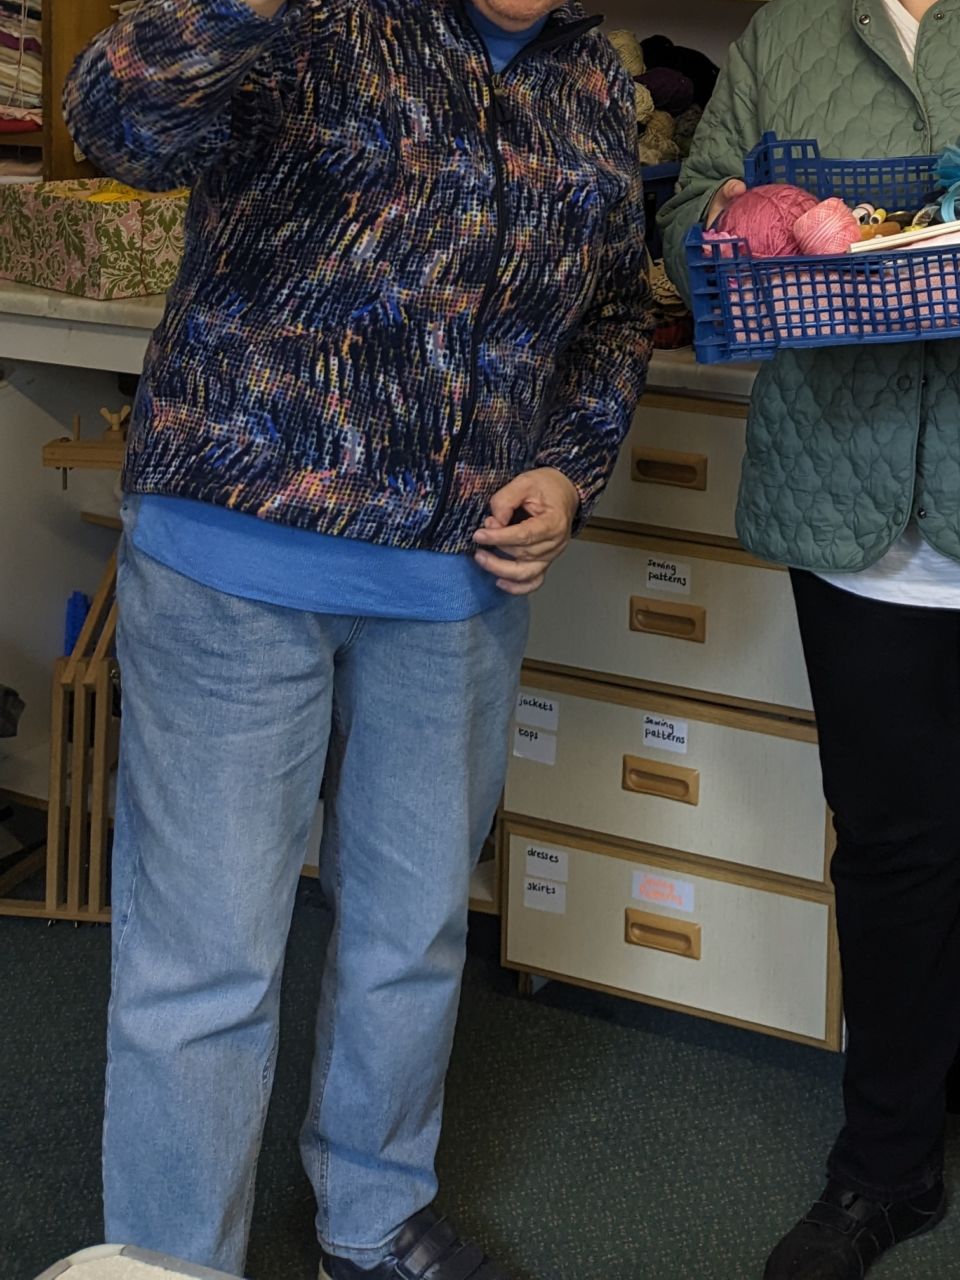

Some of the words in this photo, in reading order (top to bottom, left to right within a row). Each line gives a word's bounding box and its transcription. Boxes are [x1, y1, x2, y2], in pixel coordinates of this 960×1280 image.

[518, 693, 554, 712] jackets
[518, 727, 539, 741] tops
[527, 847, 560, 864] dresses
[526, 881, 556, 895] skirts
